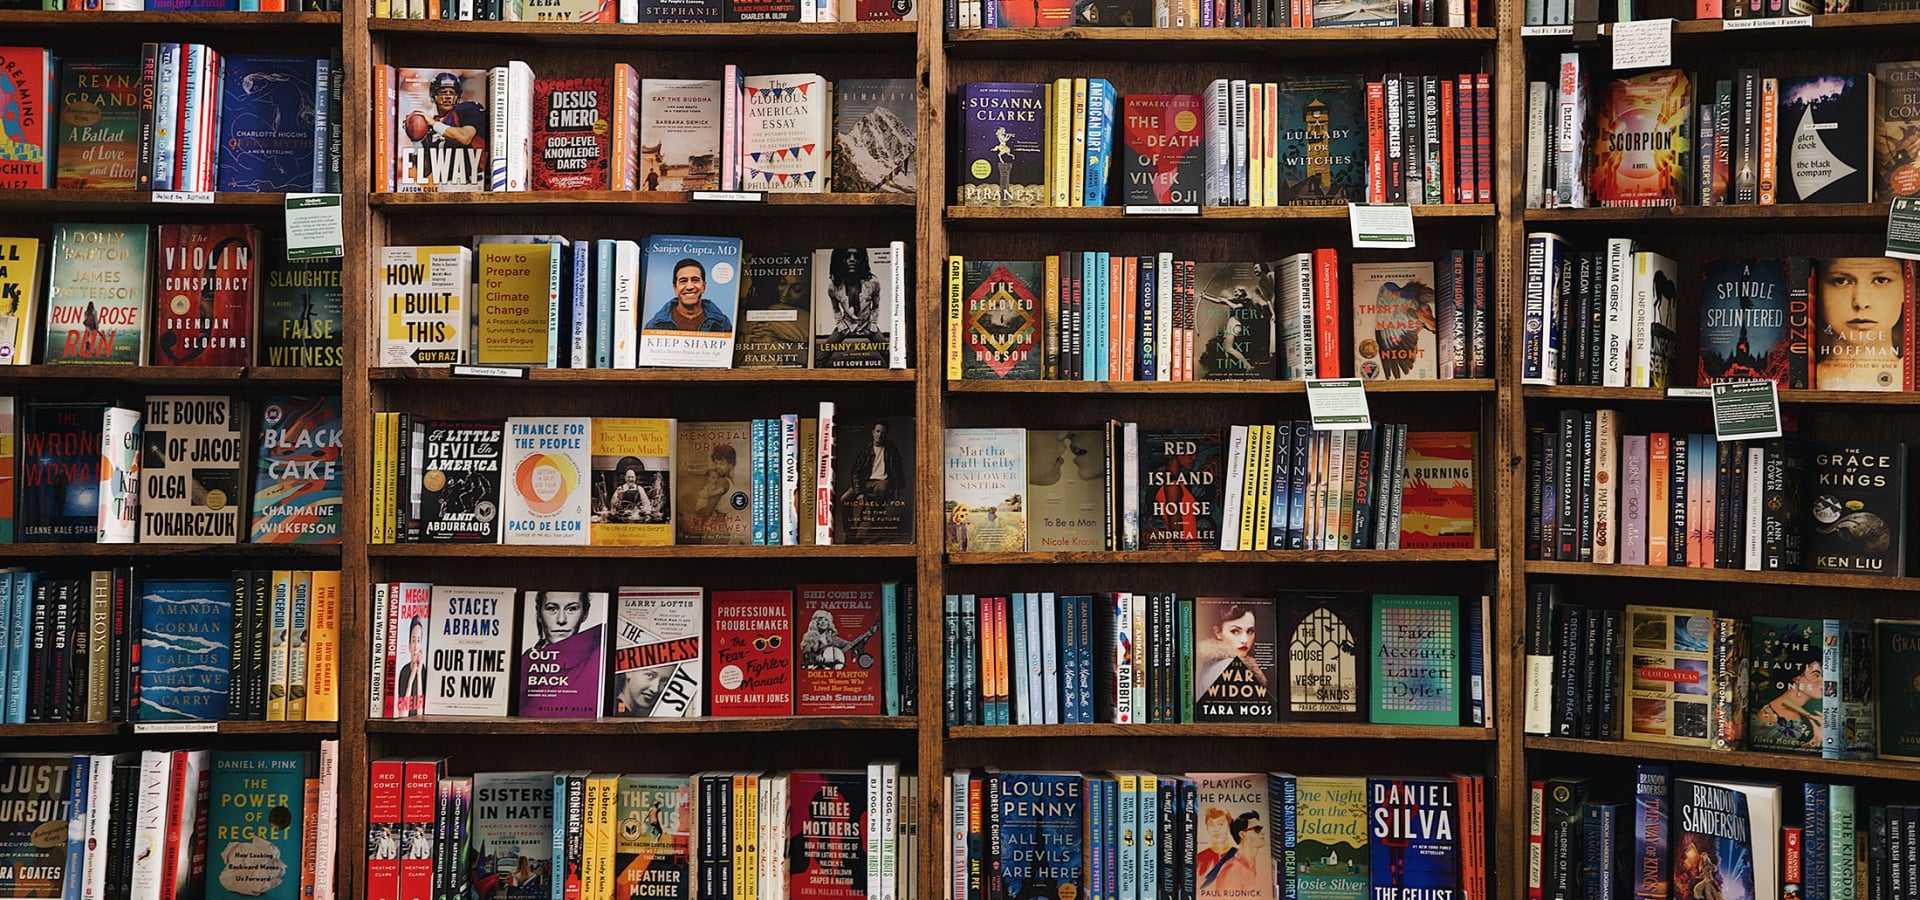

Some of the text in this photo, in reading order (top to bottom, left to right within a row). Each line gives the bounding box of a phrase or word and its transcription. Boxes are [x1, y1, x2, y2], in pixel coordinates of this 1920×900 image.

[1727, 18, 1807, 28] Science Fiction Fantasy
[553, 91, 597, 109] DESUS
[970, 98, 1042, 108] SUSANNA
[749, 106, 808, 116] AMERICAN
[977, 111, 1035, 121] CLARKE
[550, 110, 599, 127] & MERO
[762, 120, 796, 129] ESSAY
[1129, 116, 1158, 128] THE
[1388, 80, 1400, 158] SWASHBUCKLERS
[69, 129, 124, 142] A Ballad
[1147, 136, 1199, 147] DEATH
[1609, 132, 1671, 151] SCORPION
[1798, 134, 1814, 143] glen
[548, 137, 597, 148] GOD-LEVEL
[1798, 142, 1817, 150] cook
[82, 148, 124, 161] of Love
[545, 147, 600, 158] KNOWLEDGE
[557, 159, 587, 169] DARTS
[1138, 155, 1159, 165] OF
[1287, 156, 1351, 166] WITCHES
[1810, 160, 1830, 168] black
[402, 148, 483, 185] ELWAY
[1130, 173, 1178, 184] VIVEK
[1797, 169, 1832, 178] company
[1171, 191, 1197, 202] OJI
[653, 244, 736, 256] Sanjay Gupta, MD
[165, 247, 248, 270] VIOLIN
[486, 254, 527, 263] How to
[387, 264, 424, 285] HOW
[486, 268, 530, 278] Prepare
[166, 278, 248, 291] CONSPIRACY
[486, 279, 502, 288] for
[990, 282, 1014, 293] THE
[951, 261, 960, 319] CARL HIAASEN
[1717, 282, 1775, 300] SPINDLE
[393, 293, 451, 314] I BUILT
[486, 293, 529, 302] Climate
[486, 306, 529, 316] Change
[971, 300, 1033, 310] REMOVED
[52, 306, 138, 325] RUN ROSE
[1707, 308, 1783, 328] SPLINTERED
[167, 319, 228, 329] BRENDAN
[282, 320, 333, 339] FALSE
[407, 322, 445, 343] THIS
[62, 329, 115, 358] RUN
[184, 337, 247, 348] SLOCUMB
[972, 334, 1032, 344] BRANDON
[419, 350, 455, 361] GUY RAZ
[976, 351, 1028, 361] HOBSON
[1609, 334, 1618, 373] AGENCY
[174, 402, 225, 424] BOOKS
[512, 424, 584, 434] FINANCE FOR
[264, 428, 343, 448] BLACK
[515, 438, 580, 449] THE PEOPLE
[169, 438, 187, 462] OF
[1164, 442, 1196, 455] RED
[426, 460, 498, 471] AMERICA
[1817, 454, 1891, 467] GRACE
[268, 461, 335, 480] CAKE
[1415, 467, 1469, 479] BURNING
[1148, 471, 1213, 485] ISLAND
[1357, 451, 1370, 504] HOSTAGE
[1819, 474, 1886, 487] KINGS
[148, 475, 186, 498] OLGA
[262, 506, 334, 516] CHARMAINE
[1153, 502, 1210, 515] HOUSE
[145, 513, 235, 536] TOKARCZUK
[260, 523, 336, 534] WILKERSON
[426, 521, 490, 534] ABDURRAQIB
[510, 520, 581, 531] PACO DE LEON
[1150, 531, 1215, 539] ANDREA LEE
[1817, 556, 1883, 569] KEN LIU
[156, 604, 221, 615] AMANDA
[449, 598, 498, 616] STACEY
[718, 607, 786, 618] PROFESSIONAL
[155, 622, 220, 633] GORMAN
[444, 619, 500, 636] ABRAMS
[715, 620, 788, 631] TROUBLEMAKER
[434, 650, 505, 672] OUR TIME
[529, 651, 560, 660] OUT
[528, 663, 560, 673] AND
[528, 676, 568, 686] BACK
[1222, 670, 1253, 682] WAR
[1642, 669, 1697, 681] CLOUD ATLAS
[440, 676, 496, 698] IS NOW
[1119, 668, 1130, 712] RABBITS
[1208, 685, 1267, 697] WIDOW
[715, 694, 789, 703] LUVVIE AJAYI JONES
[1203, 705, 1272, 715] TARA MOSS
[218, 760, 296, 769] DANIEL H. PINK
[1002, 782, 1078, 797] LOUISE
[1203, 780, 1251, 789] PLAYING
[822, 786, 838, 797] THE
[1375, 784, 1452, 807] DANIEL
[222, 794, 289, 807] POWER
[1693, 785, 1736, 813] BRANDON
[570, 781, 580, 839] STRONGMEN
[812, 802, 849, 816] THREE
[1005, 803, 1076, 817] PENNY
[803, 821, 859, 836] MOTHERS
[1375, 808, 1452, 840] SILVA
[1682, 805, 1746, 842] SANDERSON
[218, 826, 289, 840] REGRET
[1008, 834, 1074, 846] ALL THE
[1014, 851, 1070, 862] DEVILS
[628, 870, 680, 883] HEATHER
[1003, 867, 1079, 878] ARE HERE
[630, 884, 678, 897] MCGHEE
